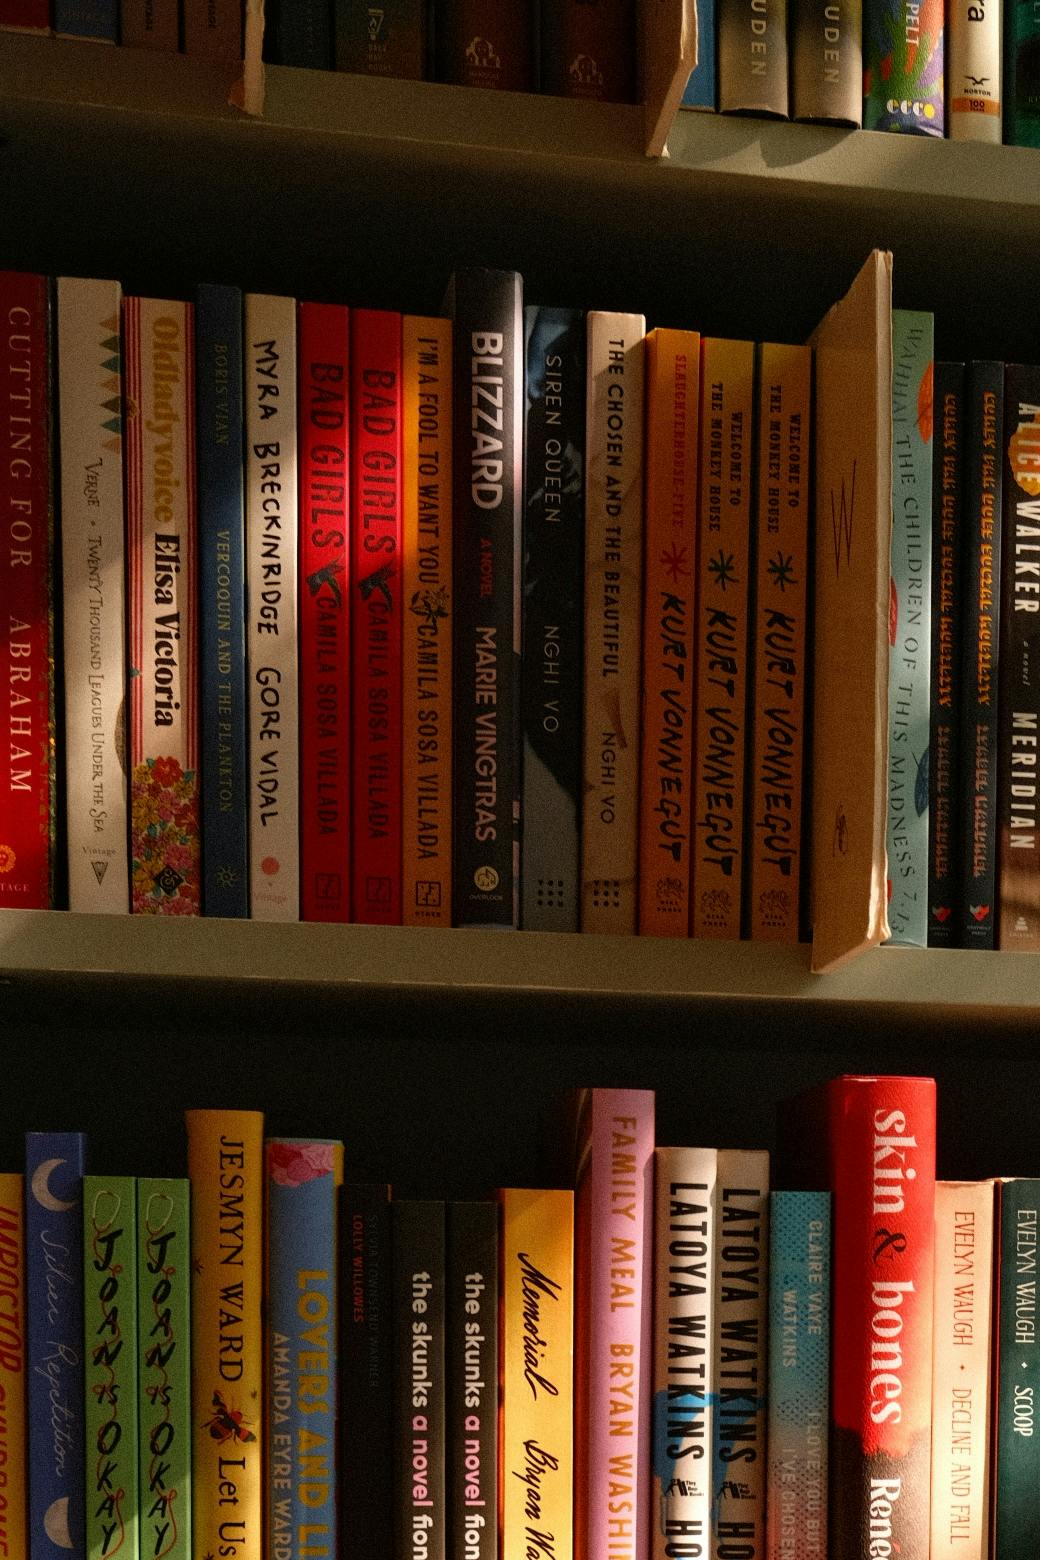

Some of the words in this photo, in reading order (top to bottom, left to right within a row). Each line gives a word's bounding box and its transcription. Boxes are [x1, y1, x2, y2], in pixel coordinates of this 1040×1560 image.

[146, 317, 181, 522] Oldladyvoice
[252, 340, 281, 420] MYRA
[470, 331, 503, 510] BLIZZARD
[153, 532, 180, 605] Elisa
[254, 444, 282, 636] BRECKINRIDGE
[1013, 501, 1040, 613] WALKER
[152, 612, 180, 727] Victoria
[474, 627, 496, 704] MARIE
[764, 608, 795, 698] KURT
[256, 668, 282, 741] GORE
[257, 751, 278, 826] VIDAL
[474, 711, 497, 841] VINGTRAS
[761, 707, 798, 876] VONNEGUT
[1009, 712, 1037, 849] MERIDIAN
[218, 1135, 244, 1266] JESMYN
[873, 1108, 917, 1215] skin
[669, 1182, 706, 1298] LATOYA
[873, 1228, 909, 1265] &
[218, 1281, 245, 1381] WARD
[411, 1272, 432, 1314] the
[411, 1322, 432, 1408] skunks
[666, 1315, 706, 1460] WATKINS
[870, 1281, 915, 1425] bones
[411, 1415, 428, 1431] a
[411, 1439, 432, 1507] novel
[218, 1457, 245, 1506] Let
[218, 1521, 245, 1557] Us
